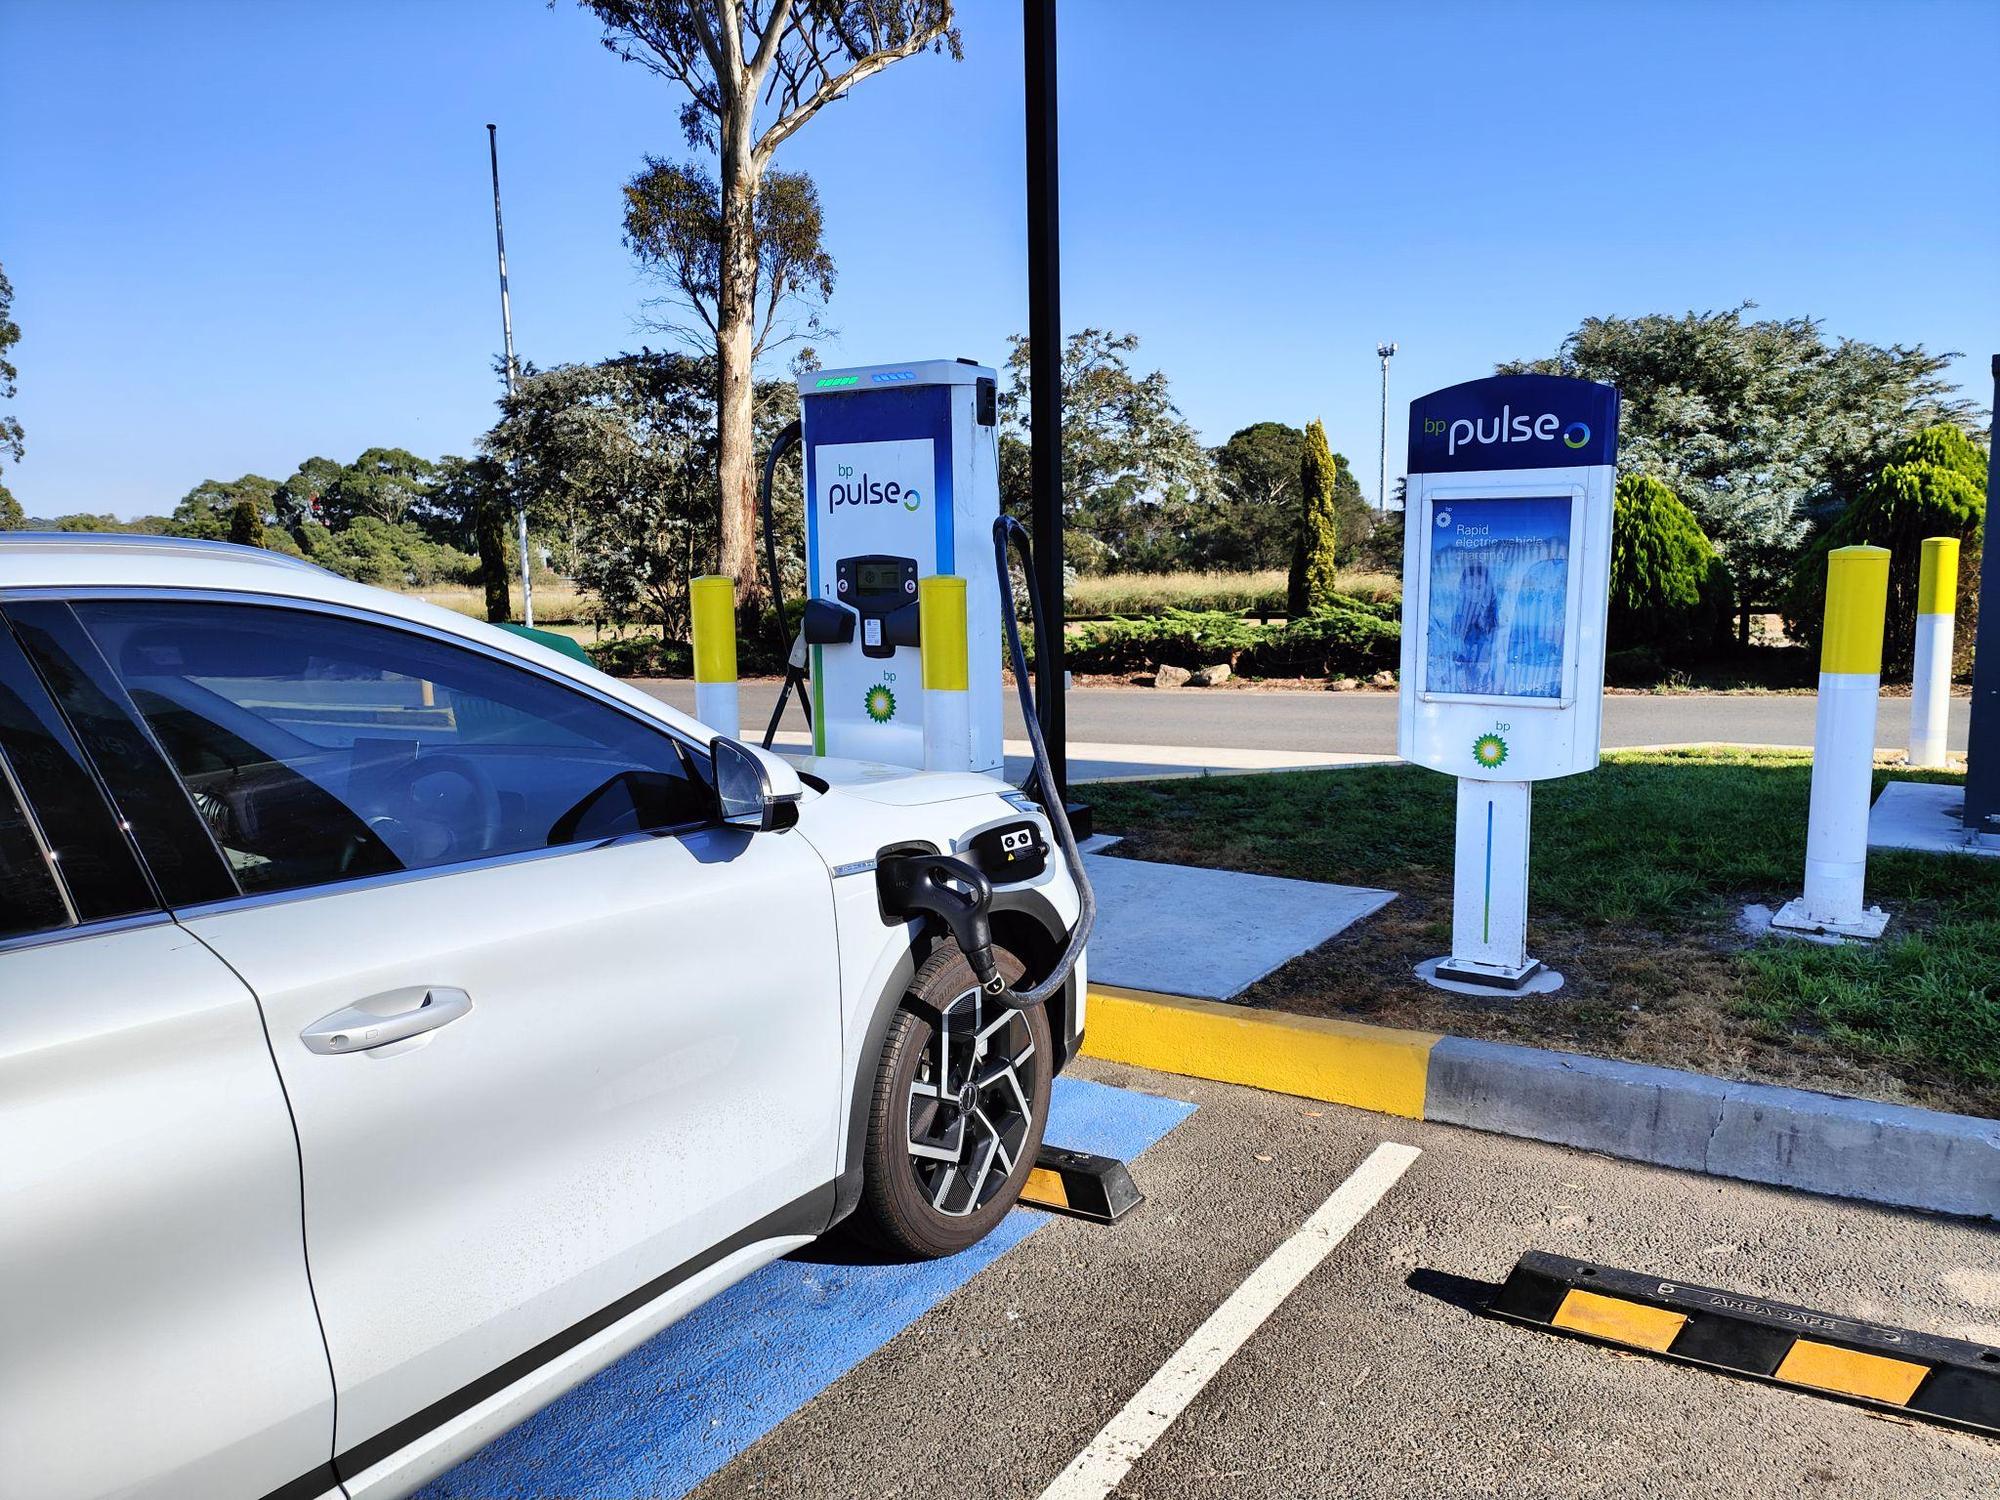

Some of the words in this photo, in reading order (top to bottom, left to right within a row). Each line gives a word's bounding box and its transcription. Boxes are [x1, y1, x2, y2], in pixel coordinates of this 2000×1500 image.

[1424, 417, 1446, 436] bp
[1449, 405, 1560, 455] pulse
[838, 463, 854, 480] bp
[830, 473, 901, 514] pulse
[1456, 523, 1489, 537] Rapid
[1455, 536, 1499, 547] electric
[883, 670, 897, 682] bp
[1496, 720, 1511, 733] bp
[1709, 1295, 1771, 1316] AREA
